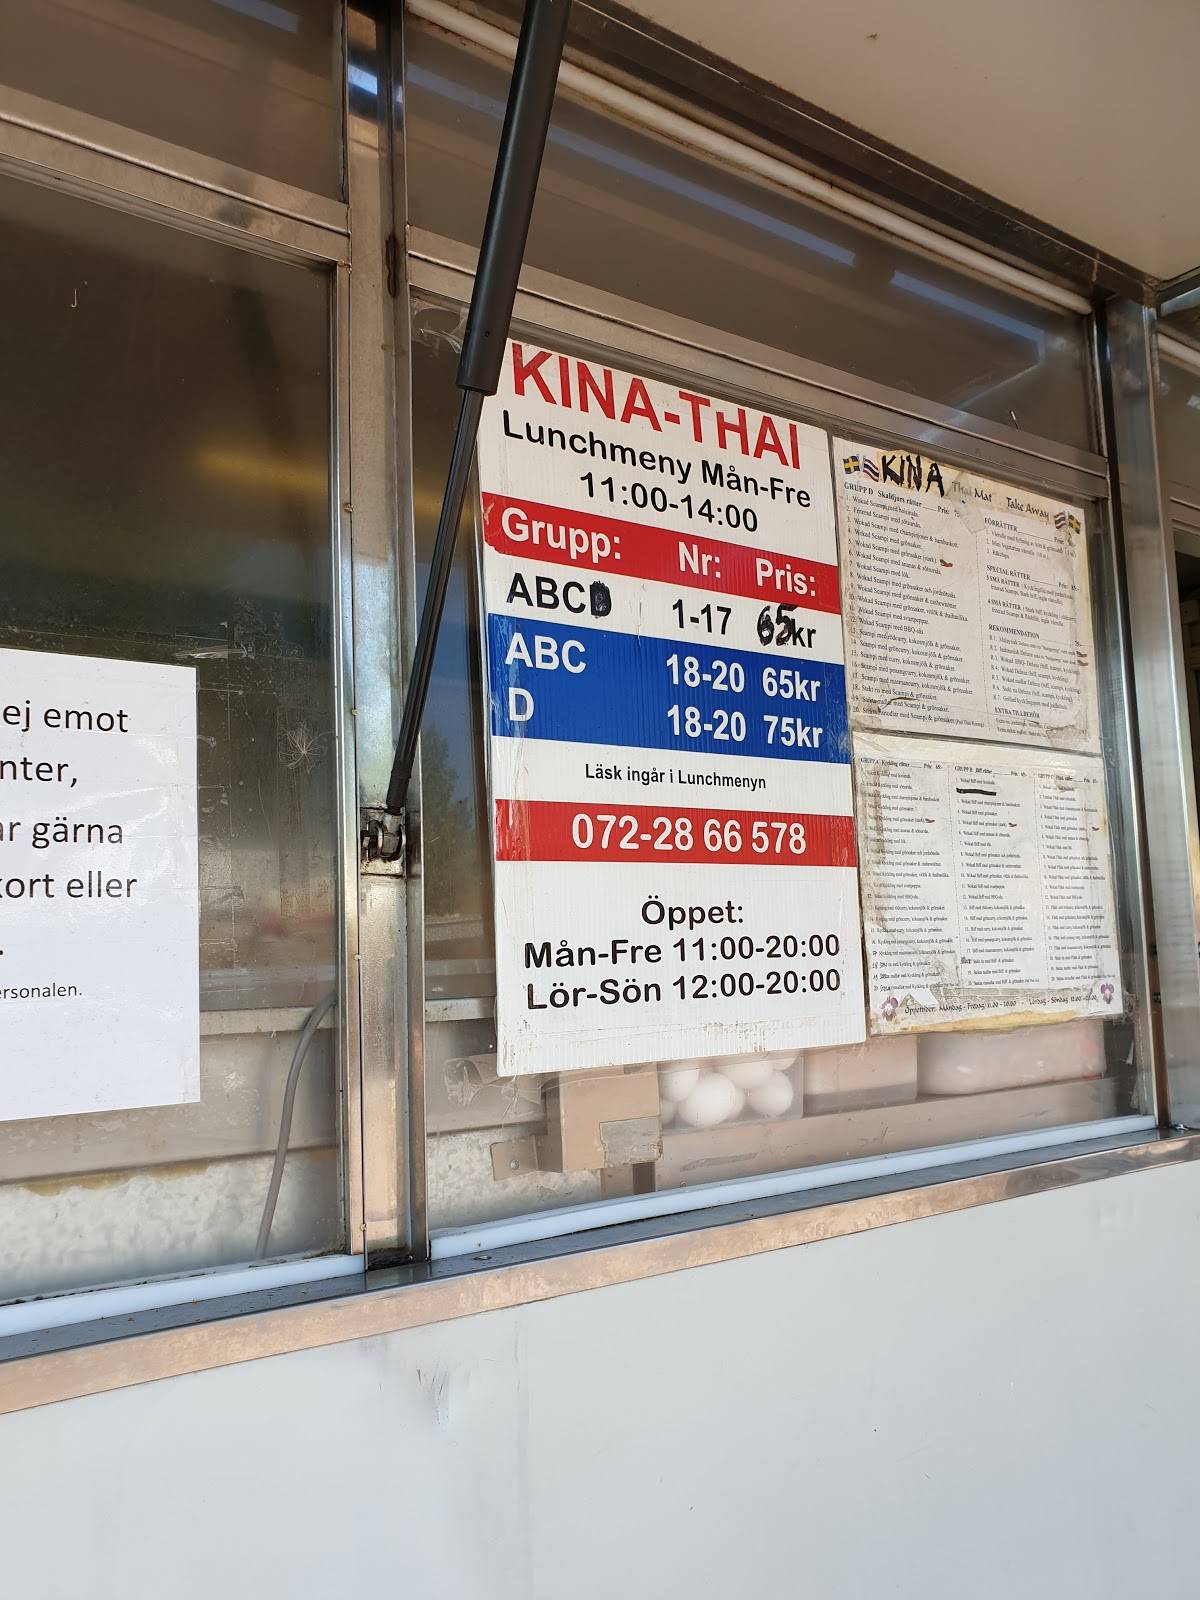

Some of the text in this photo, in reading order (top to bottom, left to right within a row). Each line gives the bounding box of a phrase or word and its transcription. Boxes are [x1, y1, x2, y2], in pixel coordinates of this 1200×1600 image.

[511, 342, 801, 470] KINA-THAI
[502, 410, 811, 508] Lunchmeny Mån-Fre
[881, 455, 945, 498] KINA
[580, 471, 758, 532] 11:00-14:00
[843, 481, 867, 494] GRUPP
[973, 486, 992, 502] Mat
[1006, 496, 1023, 511] Take
[1025, 502, 1049, 521] Away
[984, 516, 1017, 532] FÖRRÄTTER
[501, 507, 817, 597] Grupp: Nr: Pris:
[672, 599, 732, 636] 1-17
[505, 632, 821, 701] ABC 18-20 65kr
[3, 699, 129, 733] ej emot
[508, 687, 823, 748] D 18-20 75kr
[585, 763, 767, 791] Läsk ingår i Lunchmenyn
[32, 816, 124, 849] gärna
[572, 813, 807, 855] 072-28 66 578
[66, 870, 138, 898] eller
[641, 895, 744, 930] Öppet:
[524, 933, 840, 969] Mån-Fre 11:00-20:00
[0, 982, 83, 999] rsonalen.
[527, 968, 841, 1010] Lör-Sön 12:00-20:00
